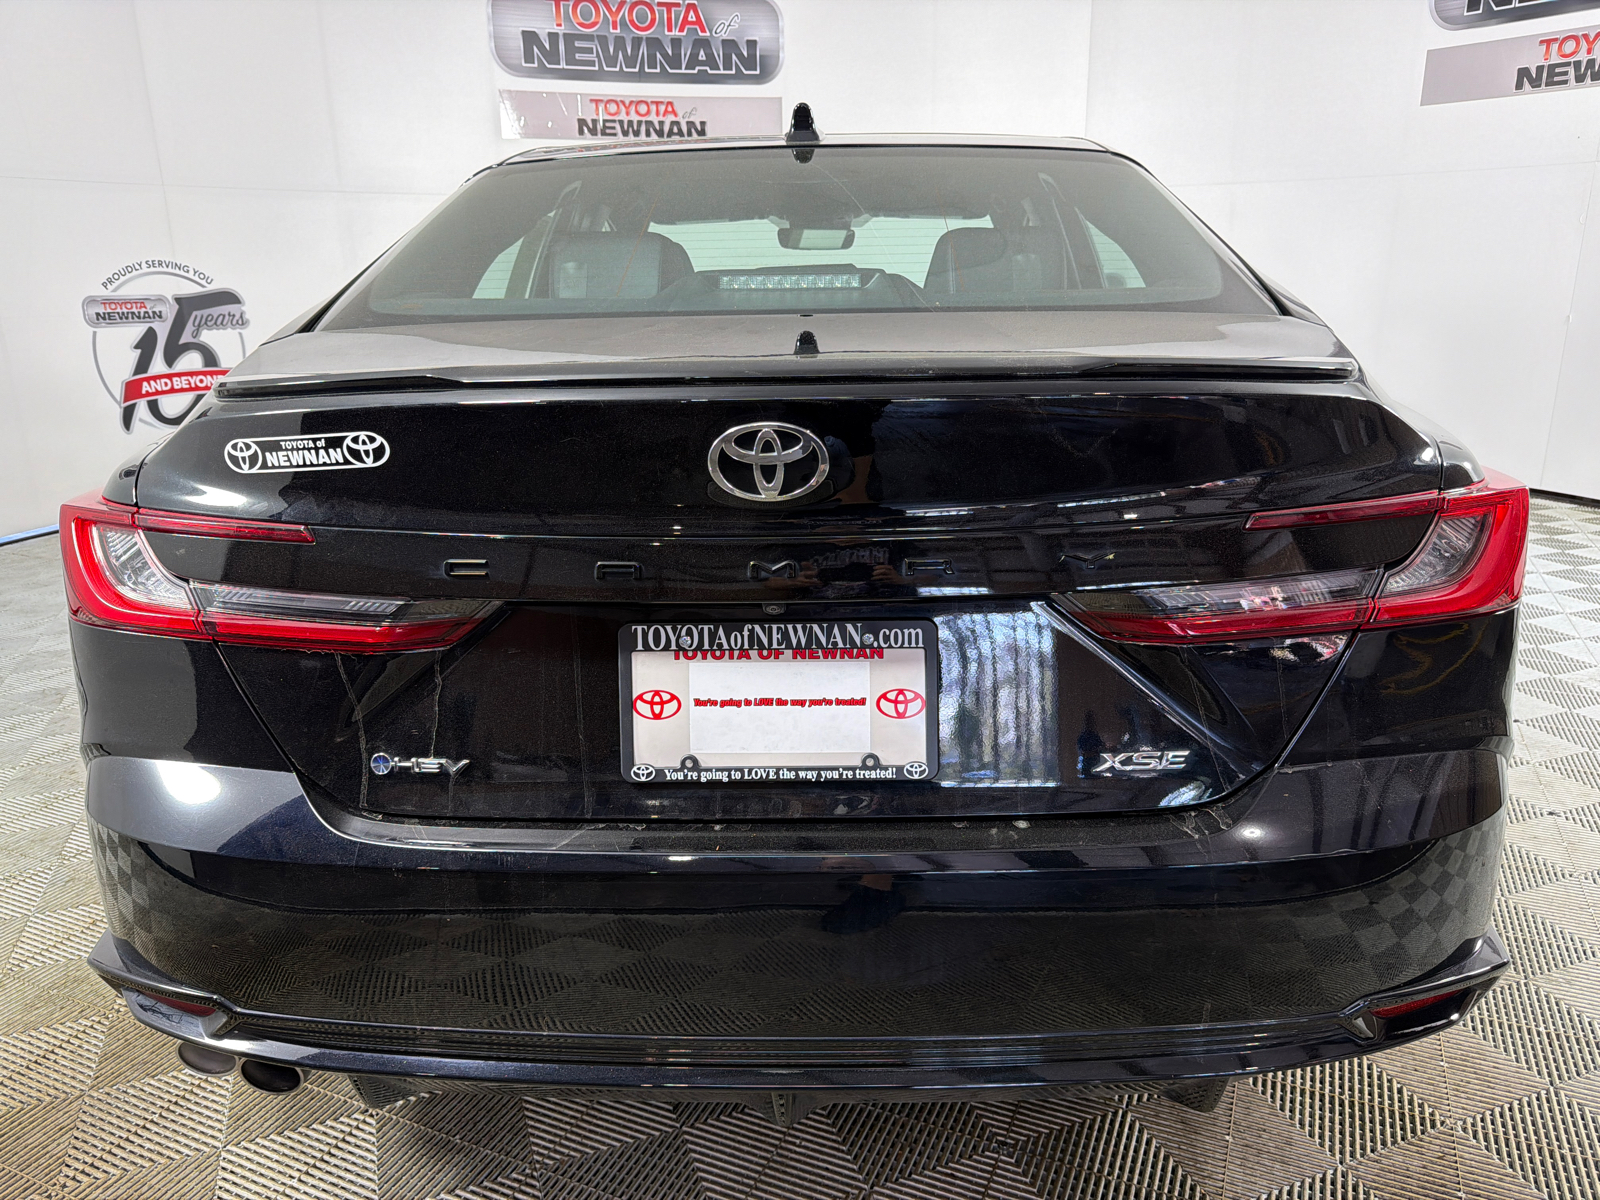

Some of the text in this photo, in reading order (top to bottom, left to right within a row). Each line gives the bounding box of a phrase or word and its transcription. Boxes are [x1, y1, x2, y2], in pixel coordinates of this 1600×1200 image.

[548, 0, 741, 36] TOYOTA of
[520, 30, 760, 74] NEWNAN
[589, 98, 698, 120] TOYOTA of
[577, 117, 707, 138] NEWNAN
[101, 259, 214, 290] PROUDLY SERVING YOU
[95, 310, 163, 321] NEWNAN
[100, 301, 148, 311] TOYOTA
[191, 311, 248, 339] years
[141, 375, 225, 394] AND BEYON
[280, 438, 326, 449] TOYOTA of
[265, 448, 344, 467] NEWNAN
[693, 697, 867, 708] You're going to LOVE the way you're treated!
[1092, 750, 1190, 772] XSE
[663, 767, 897, 783] You're going to LOVE the way you're treated!
